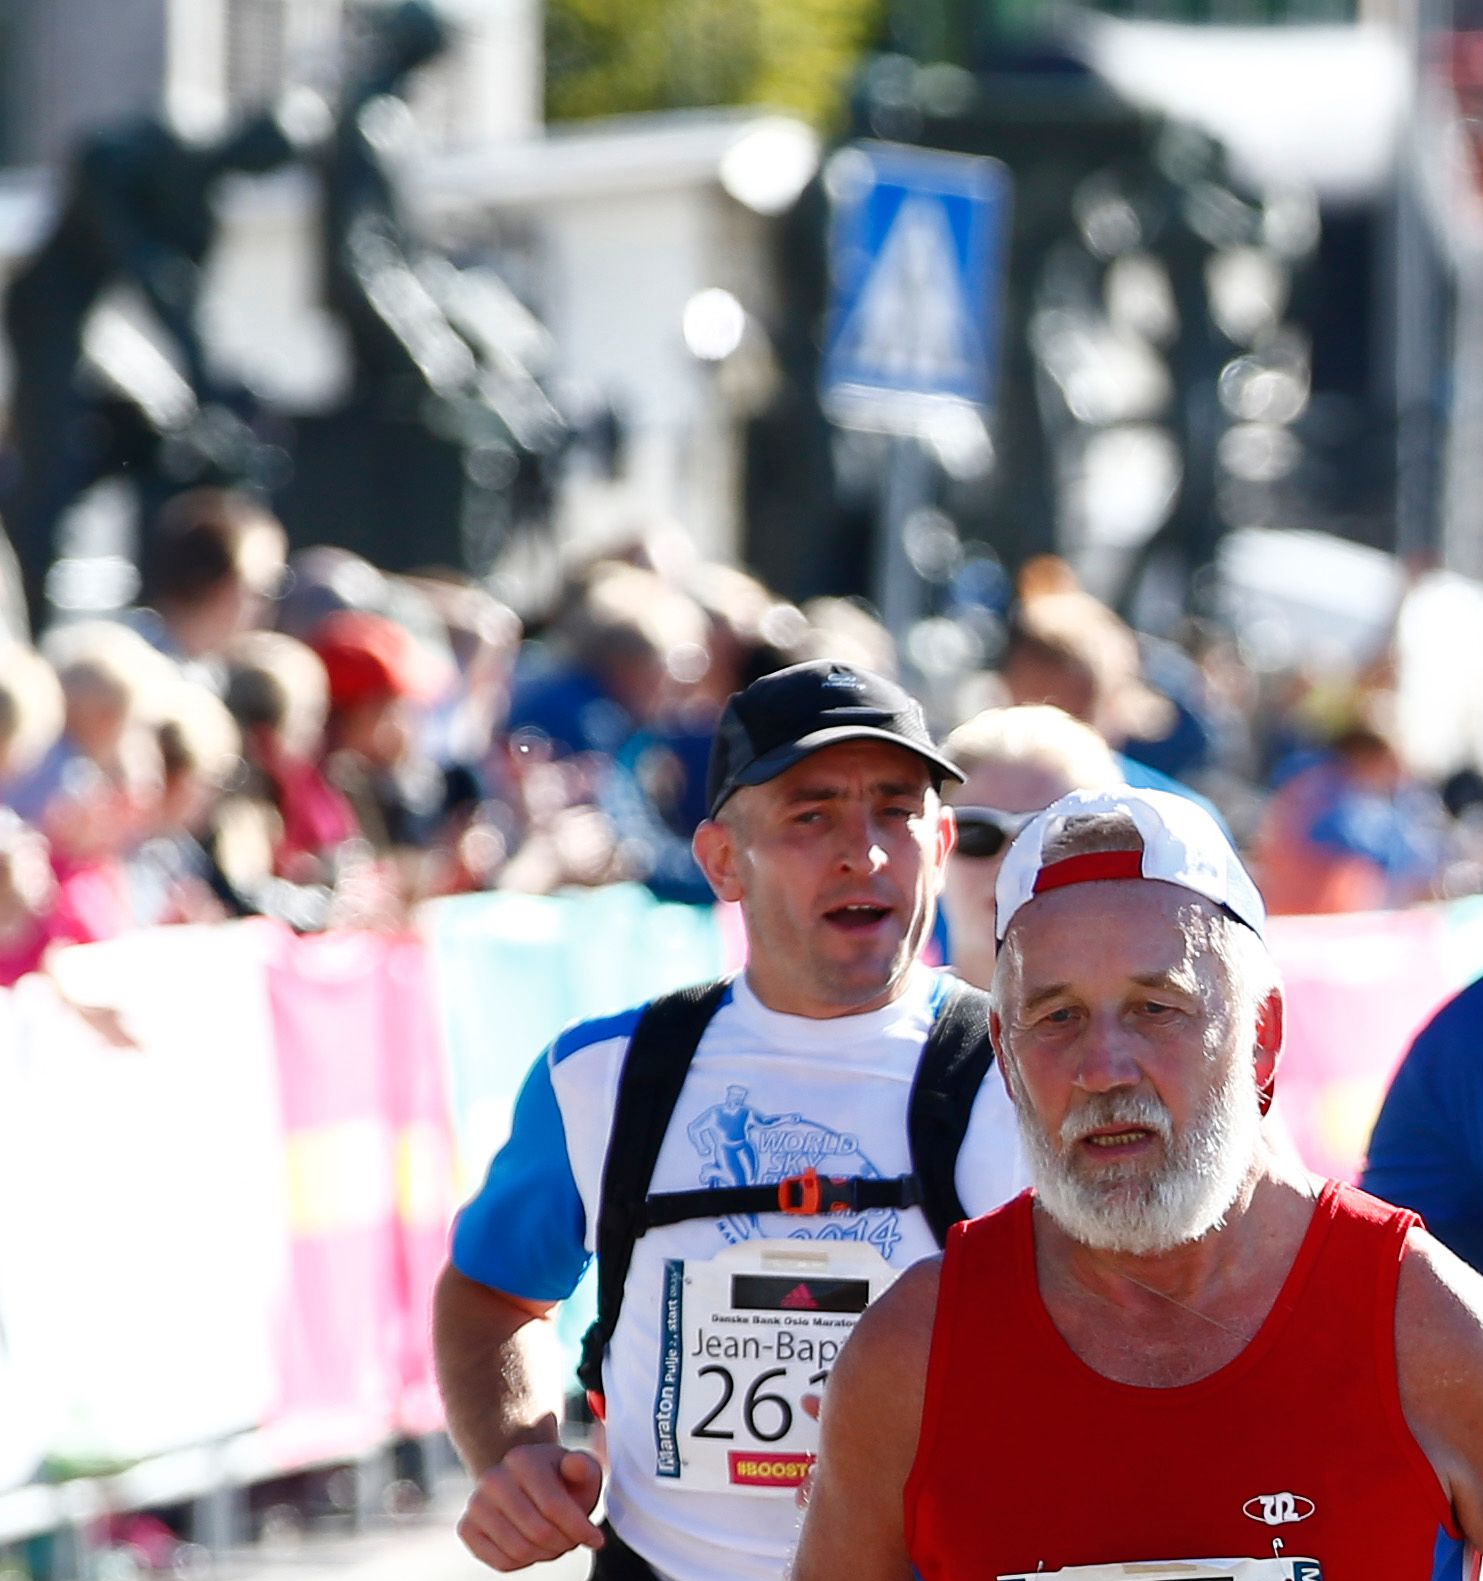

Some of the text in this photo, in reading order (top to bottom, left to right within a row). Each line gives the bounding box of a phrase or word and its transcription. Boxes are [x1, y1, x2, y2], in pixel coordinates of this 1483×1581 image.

[758, 1130, 859, 1153] WORLD
[768, 1152, 827, 1174] SKY
[667, 1299, 678, 1332] start
[712, 1314, 749, 1325] Danske
[752, 1315, 780, 1325] Bank
[784, 1316, 809, 1326] Oslo
[691, 1328, 846, 1369] Jean-Bap
[664, 1348, 679, 1383] Pulje
[656, 1386, 675, 1473] Maraton
